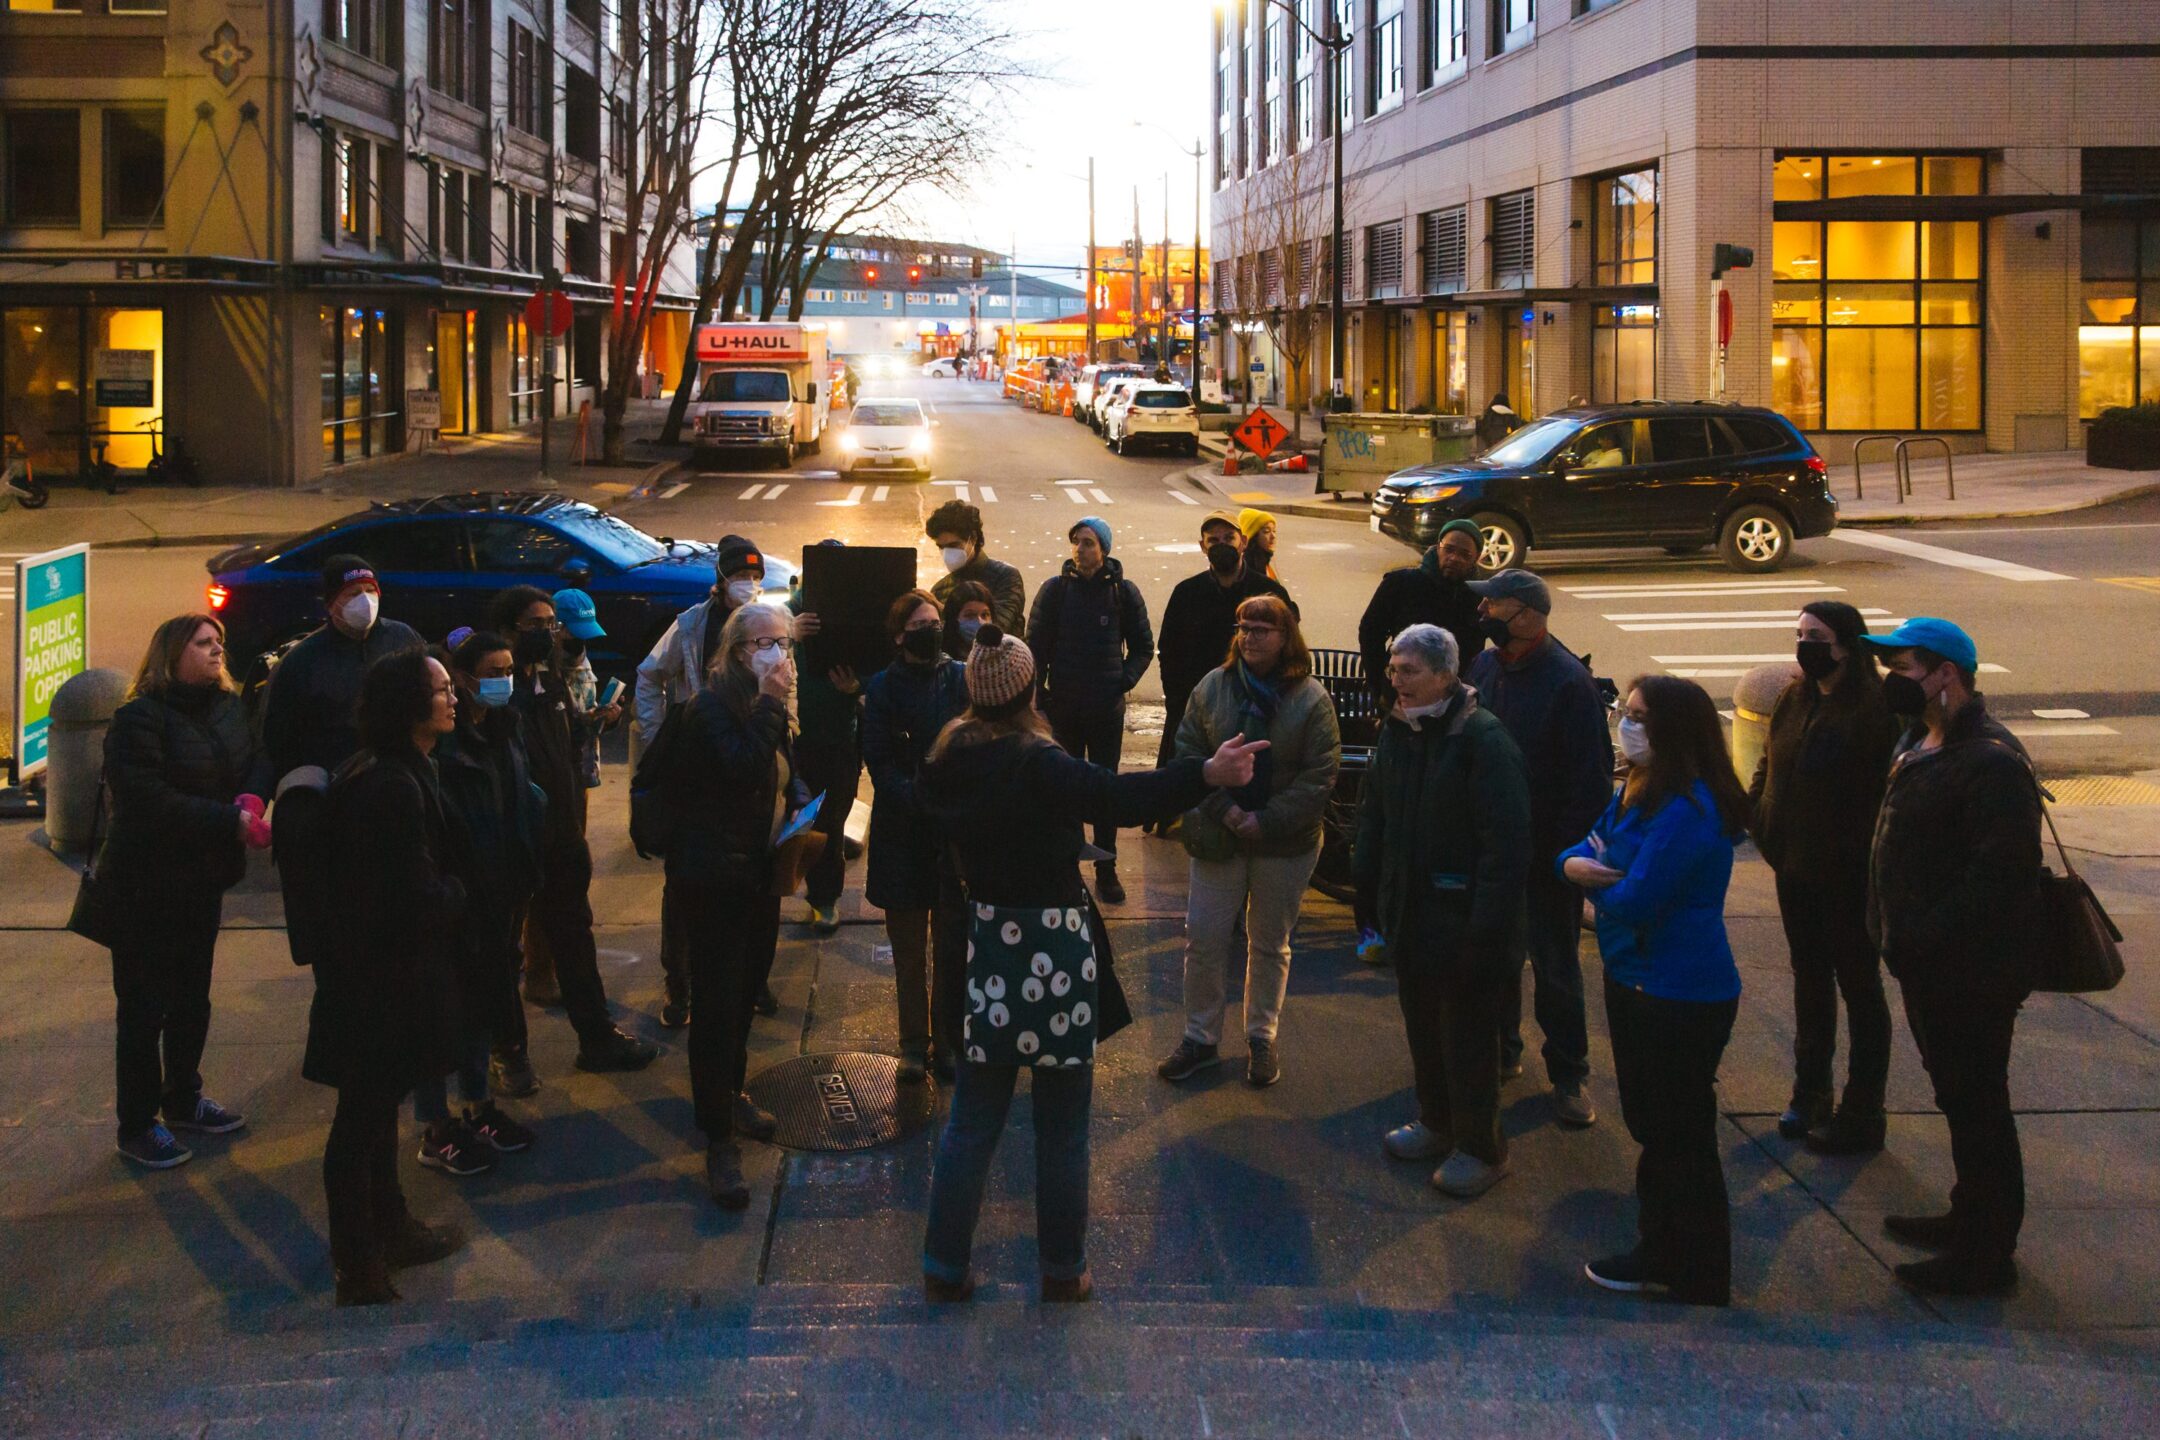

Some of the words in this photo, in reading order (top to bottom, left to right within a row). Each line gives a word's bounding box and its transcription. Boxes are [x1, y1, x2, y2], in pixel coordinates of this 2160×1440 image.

[710, 336, 791, 349] U-HAUL
[29, 612, 77, 651] PUBLIC
[24, 637, 82, 680] PARKING
[820, 1074, 857, 1124] SEWER
